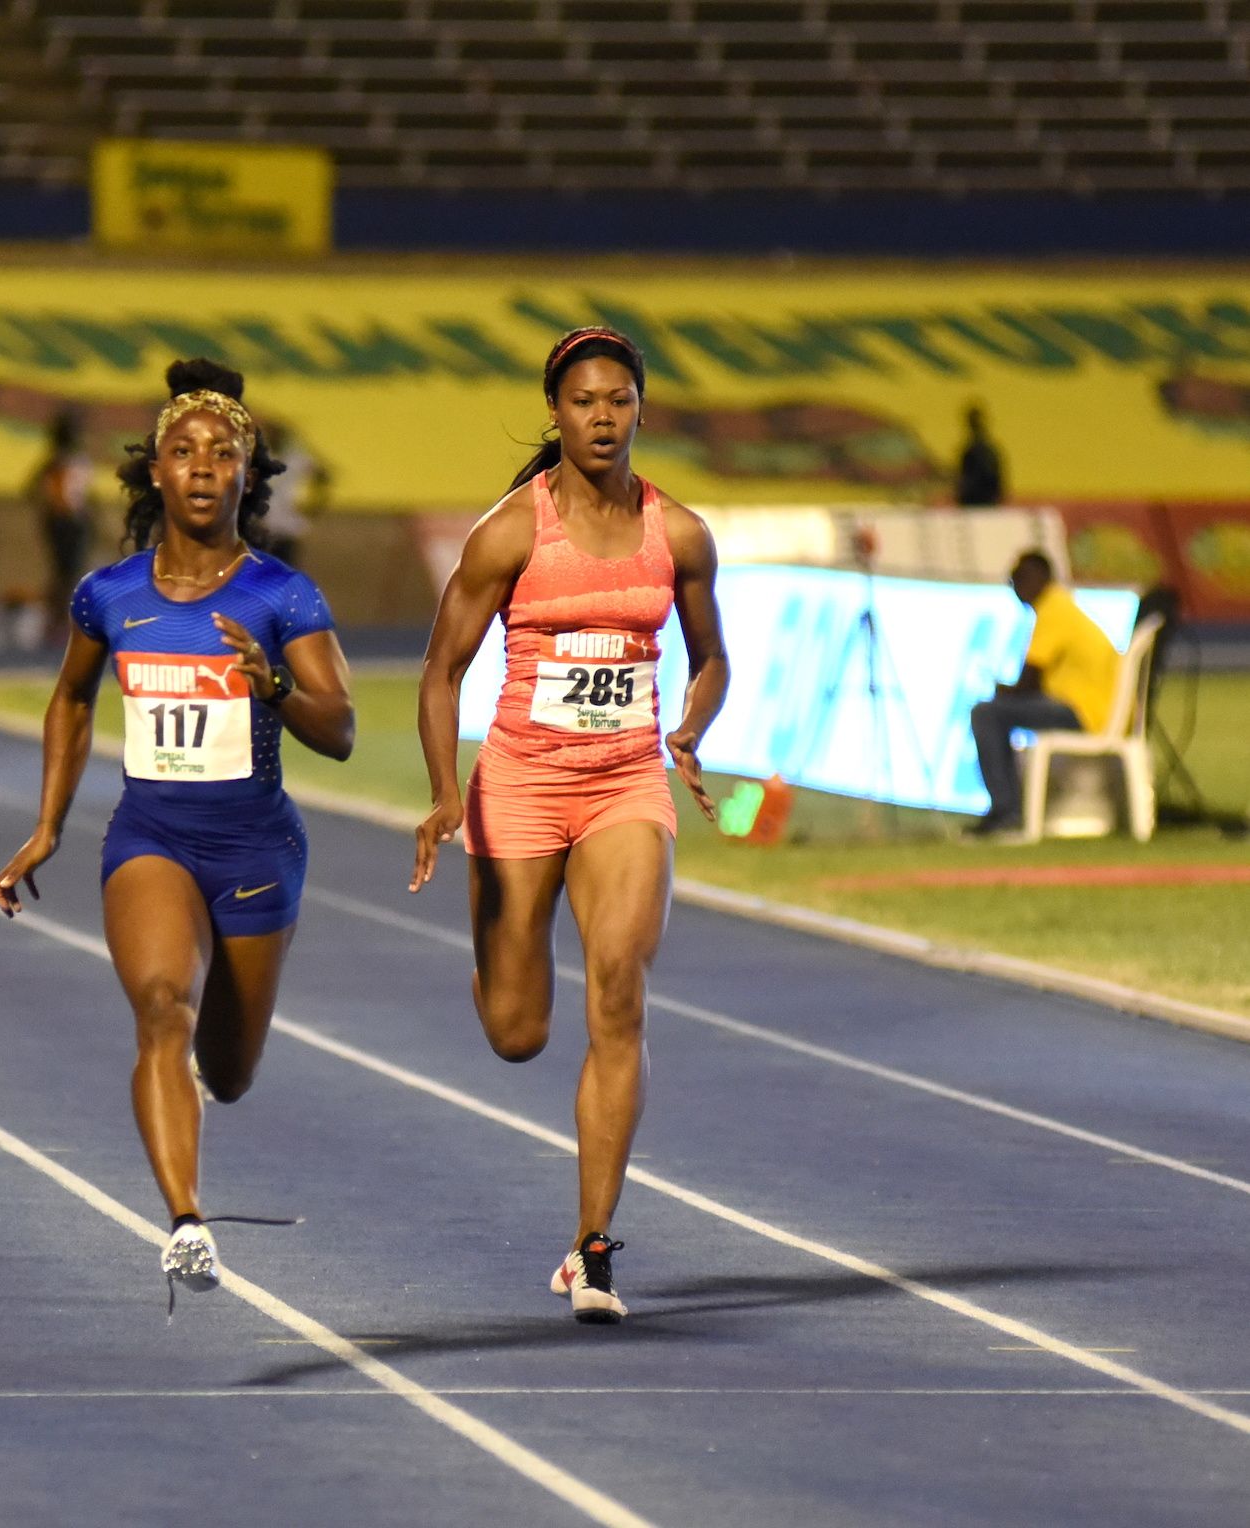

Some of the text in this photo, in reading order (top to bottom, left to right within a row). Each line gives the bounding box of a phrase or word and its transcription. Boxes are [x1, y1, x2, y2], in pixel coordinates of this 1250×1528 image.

[555, 632, 625, 658] PUMA
[127, 663, 196, 693] PUMA
[562, 667, 635, 707] 285
[148, 703, 208, 748] 117
